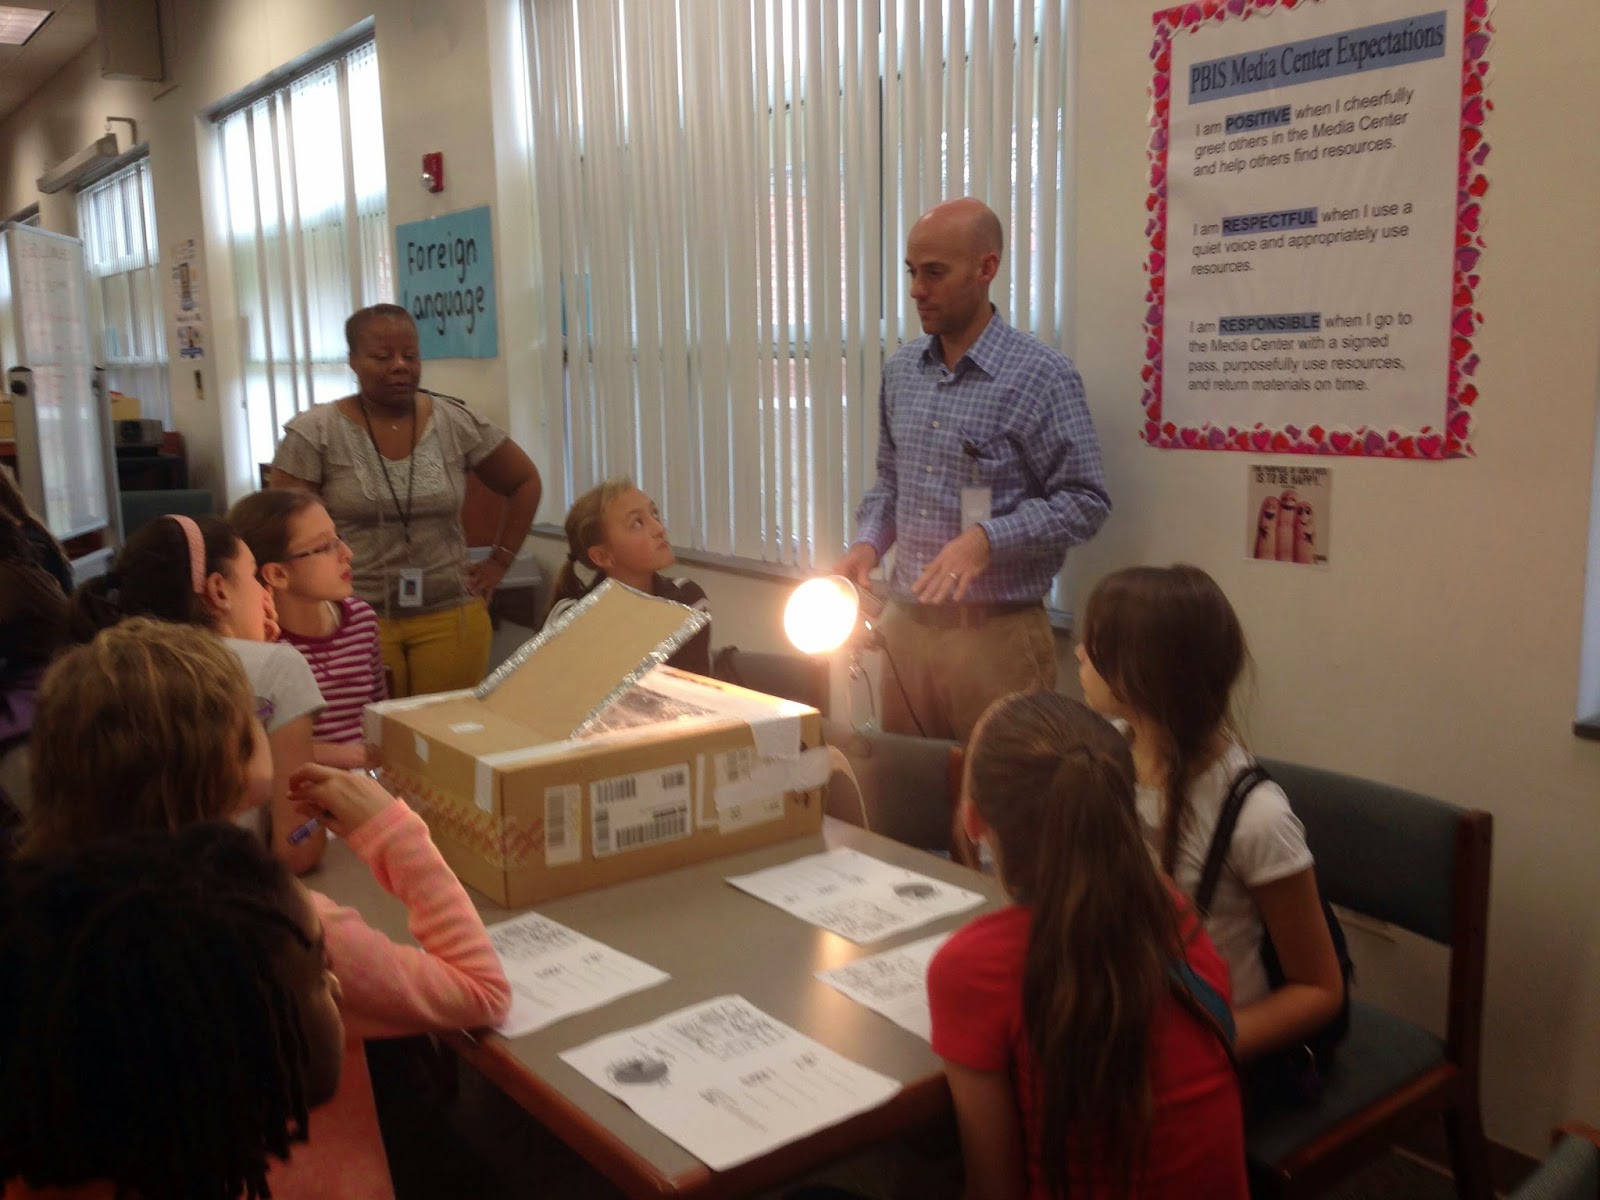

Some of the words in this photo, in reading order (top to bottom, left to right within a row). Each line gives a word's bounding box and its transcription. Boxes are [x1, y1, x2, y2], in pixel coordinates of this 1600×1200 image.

[1191, 62, 1227, 95] PBIS
[1230, 54, 1276, 86] Media
[1281, 45, 1331, 76] Center
[1337, 21, 1445, 69] Expectations
[1202, 121, 1222, 136] am
[1225, 107, 1291, 132] POSITIVE
[1294, 103, 1332, 120] when
[1343, 87, 1415, 112] cheerfully
[1194, 142, 1226, 161] greet
[1229, 135, 1269, 155] others
[1272, 131, 1285, 146] in
[1287, 127, 1308, 143] the
[1312, 120, 1355, 139] Media
[1359, 112, 1409, 131] Center
[1193, 162, 1217, 177] and
[1219, 157, 1245, 176] help
[1249, 151, 1291, 170] others
[1294, 145, 1319, 162] find
[1322, 135, 1397, 158] resources.
[1200, 222, 1219, 235] am
[1222, 210, 1318, 233] RESPECTFUL
[1321, 206, 1359, 222] when
[1371, 203, 1399, 218] use
[1403, 202, 1413, 214] a
[1192, 240, 1222, 257] quiet
[1225, 237, 1258, 253] voice
[1260, 234, 1285, 250] and
[1288, 224, 1379, 248] appropriately
[1382, 223, 1410, 238] use
[407, 231, 478, 284] Foreign
[1191, 260, 1255, 275] resources.
[1196, 321, 1217, 334] am
[1219, 314, 1321, 333] RESPONSIBLE
[1325, 313, 1363, 328] when
[1375, 314, 1395, 329] go
[1398, 311, 1413, 326] to
[1188, 339, 1208, 353] the
[1210, 338, 1248, 353] Media
[1250, 337, 1295, 352] Center
[1298, 335, 1326, 350] with
[1328, 338, 1338, 349] a
[1341, 334, 1390, 352] signed
[1188, 361, 1220, 374] pass,
[1223, 356, 1299, 374] purposefully
[1303, 359, 1329, 371] use
[1331, 355, 1406, 371] resources,
[1188, 377, 1211, 391] and
[1213, 377, 1250, 391] return
[1252, 376, 1312, 391] materials
[1314, 379, 1332, 390] on
[1335, 376, 1370, 391] time.
